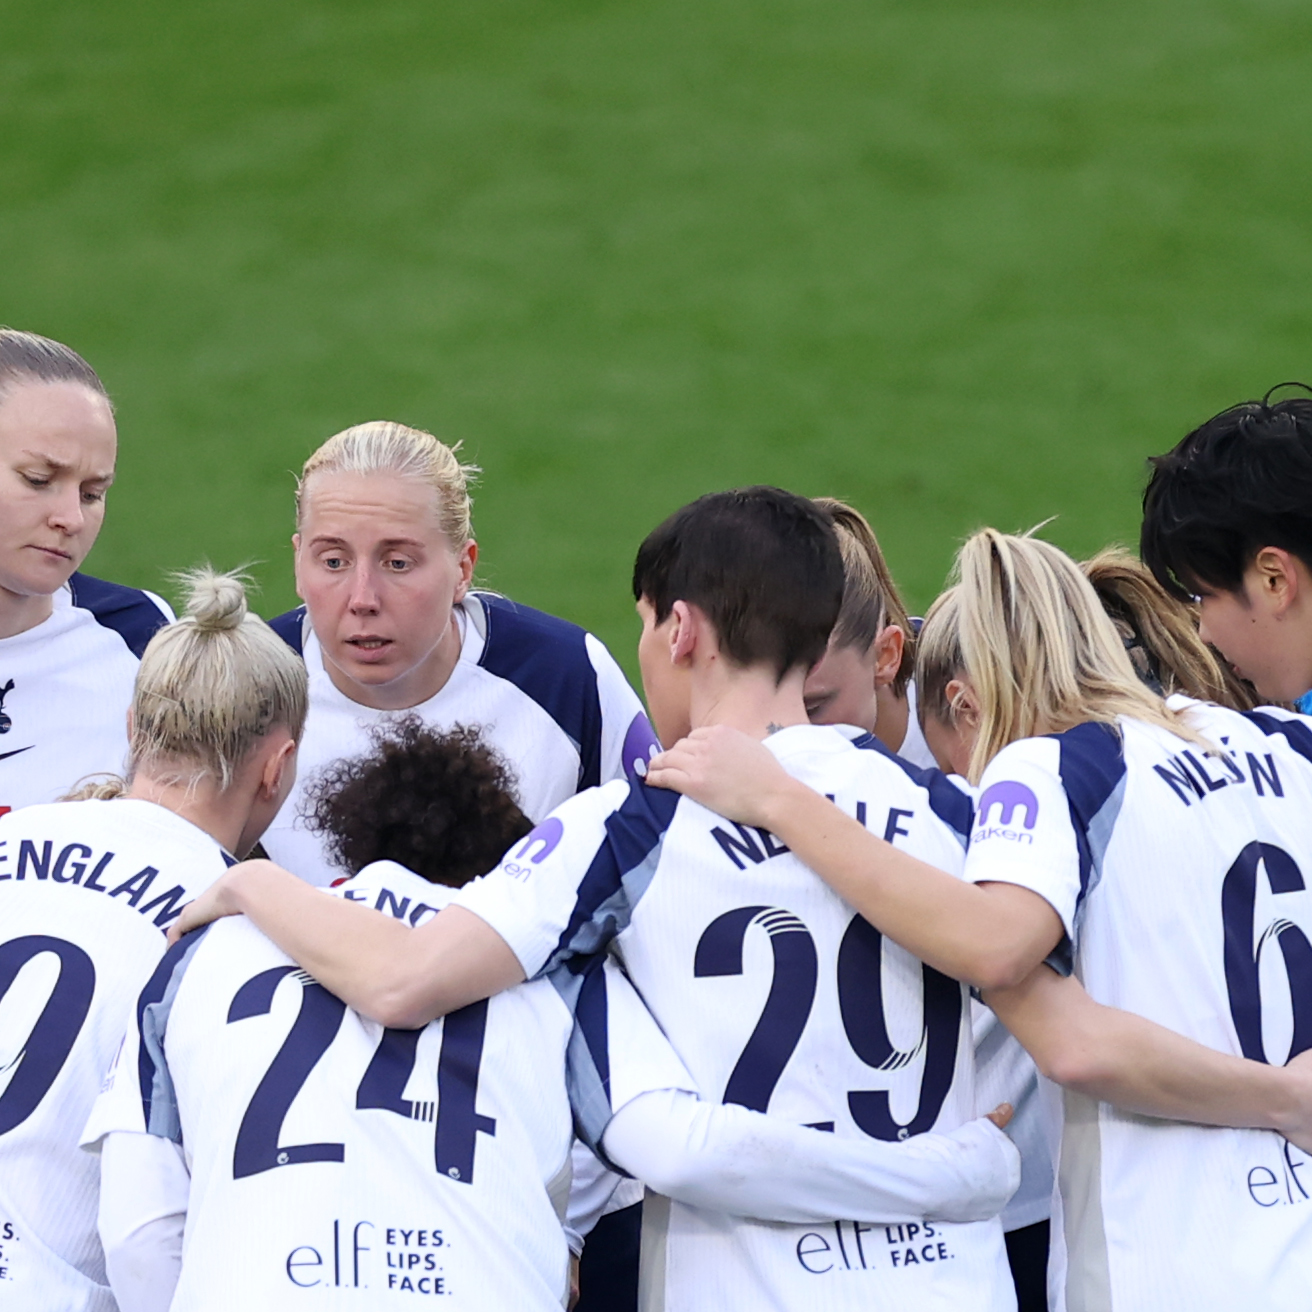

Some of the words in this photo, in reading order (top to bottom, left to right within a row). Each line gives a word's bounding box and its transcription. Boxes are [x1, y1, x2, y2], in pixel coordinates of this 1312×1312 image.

[694, 905, 962, 1143] 29
[226, 965, 497, 1185] 24
[386, 1228, 451, 1248] EYES.
[885, 1220, 943, 1245] LIPS.
[386, 1251, 444, 1272] LIPS.
[890, 1242, 955, 1268] FACE.
[388, 1273, 453, 1295] FACE.
